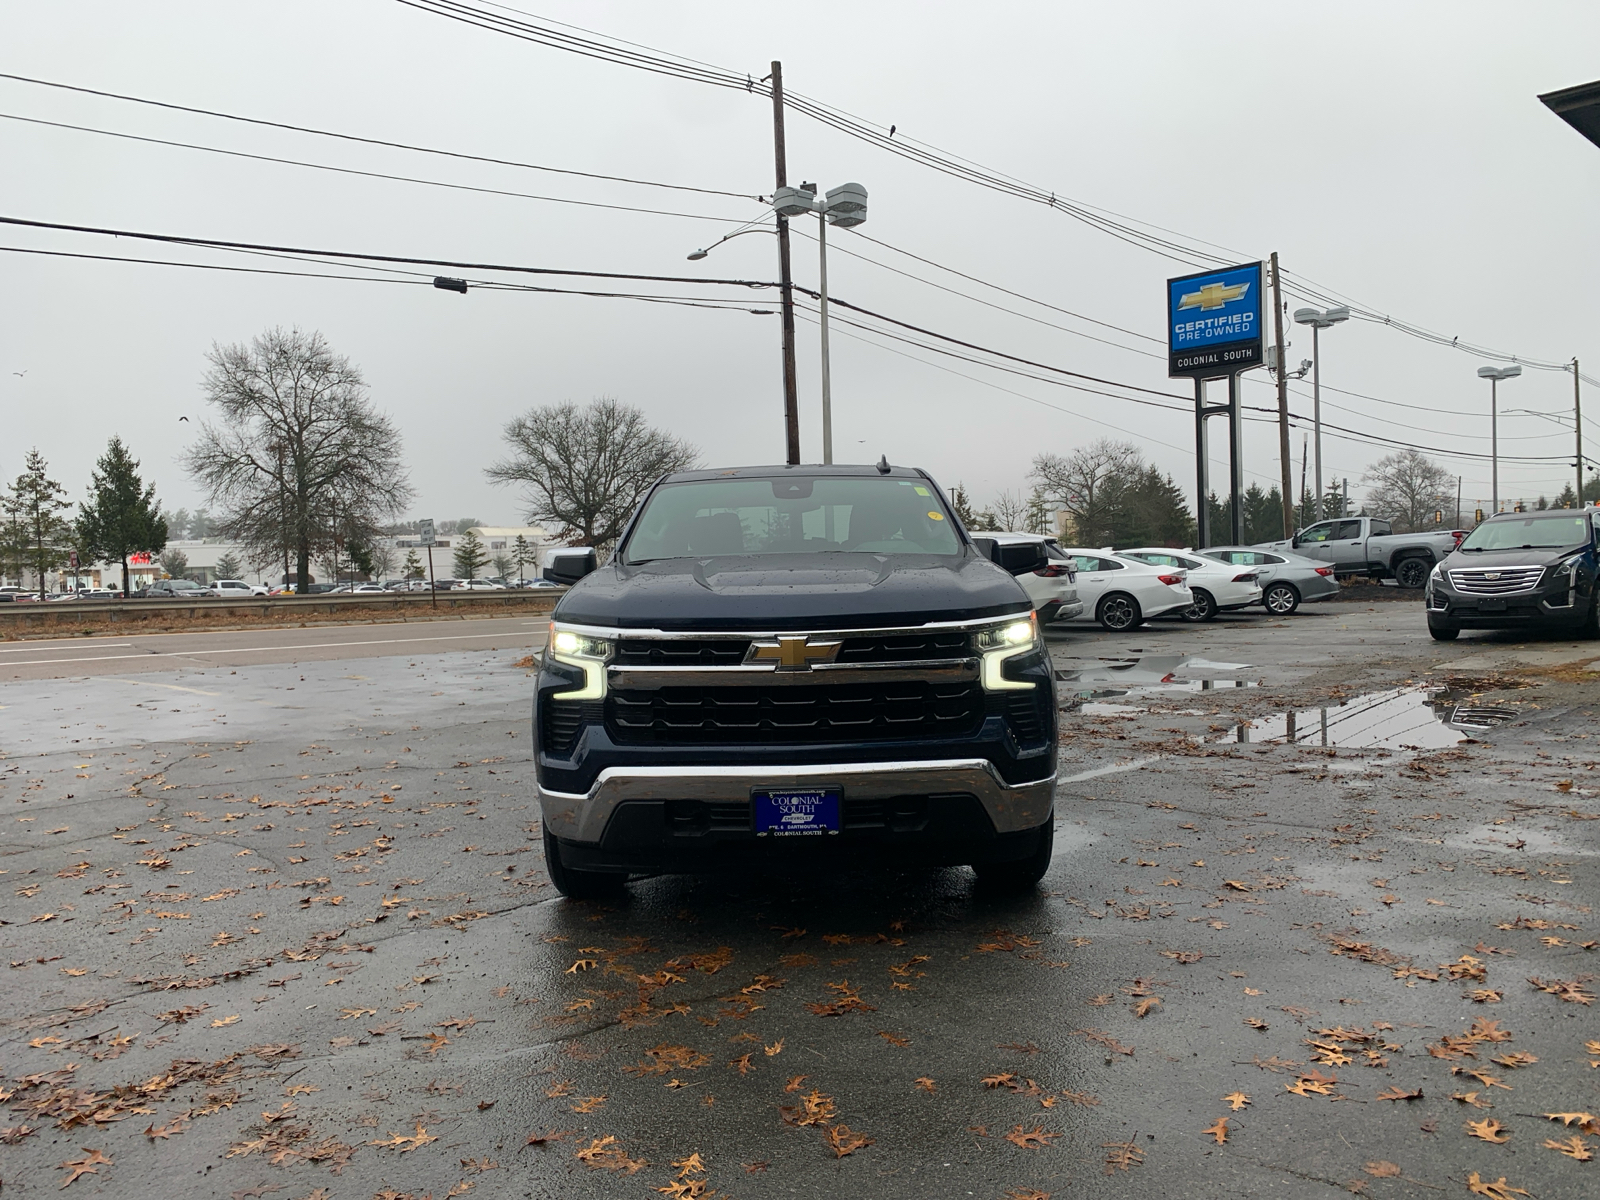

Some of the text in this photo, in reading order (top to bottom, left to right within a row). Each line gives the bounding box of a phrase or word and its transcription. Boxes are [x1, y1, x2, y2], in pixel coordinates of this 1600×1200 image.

[1175, 312, 1254, 333] CERTIFIED
[1179, 323, 1250, 342] PRE-OWNED
[1178, 349, 1252, 367] COLONIAL SOUTH
[771, 796, 823, 805] COLONIAL
[779, 805, 815, 813] SOUTH
